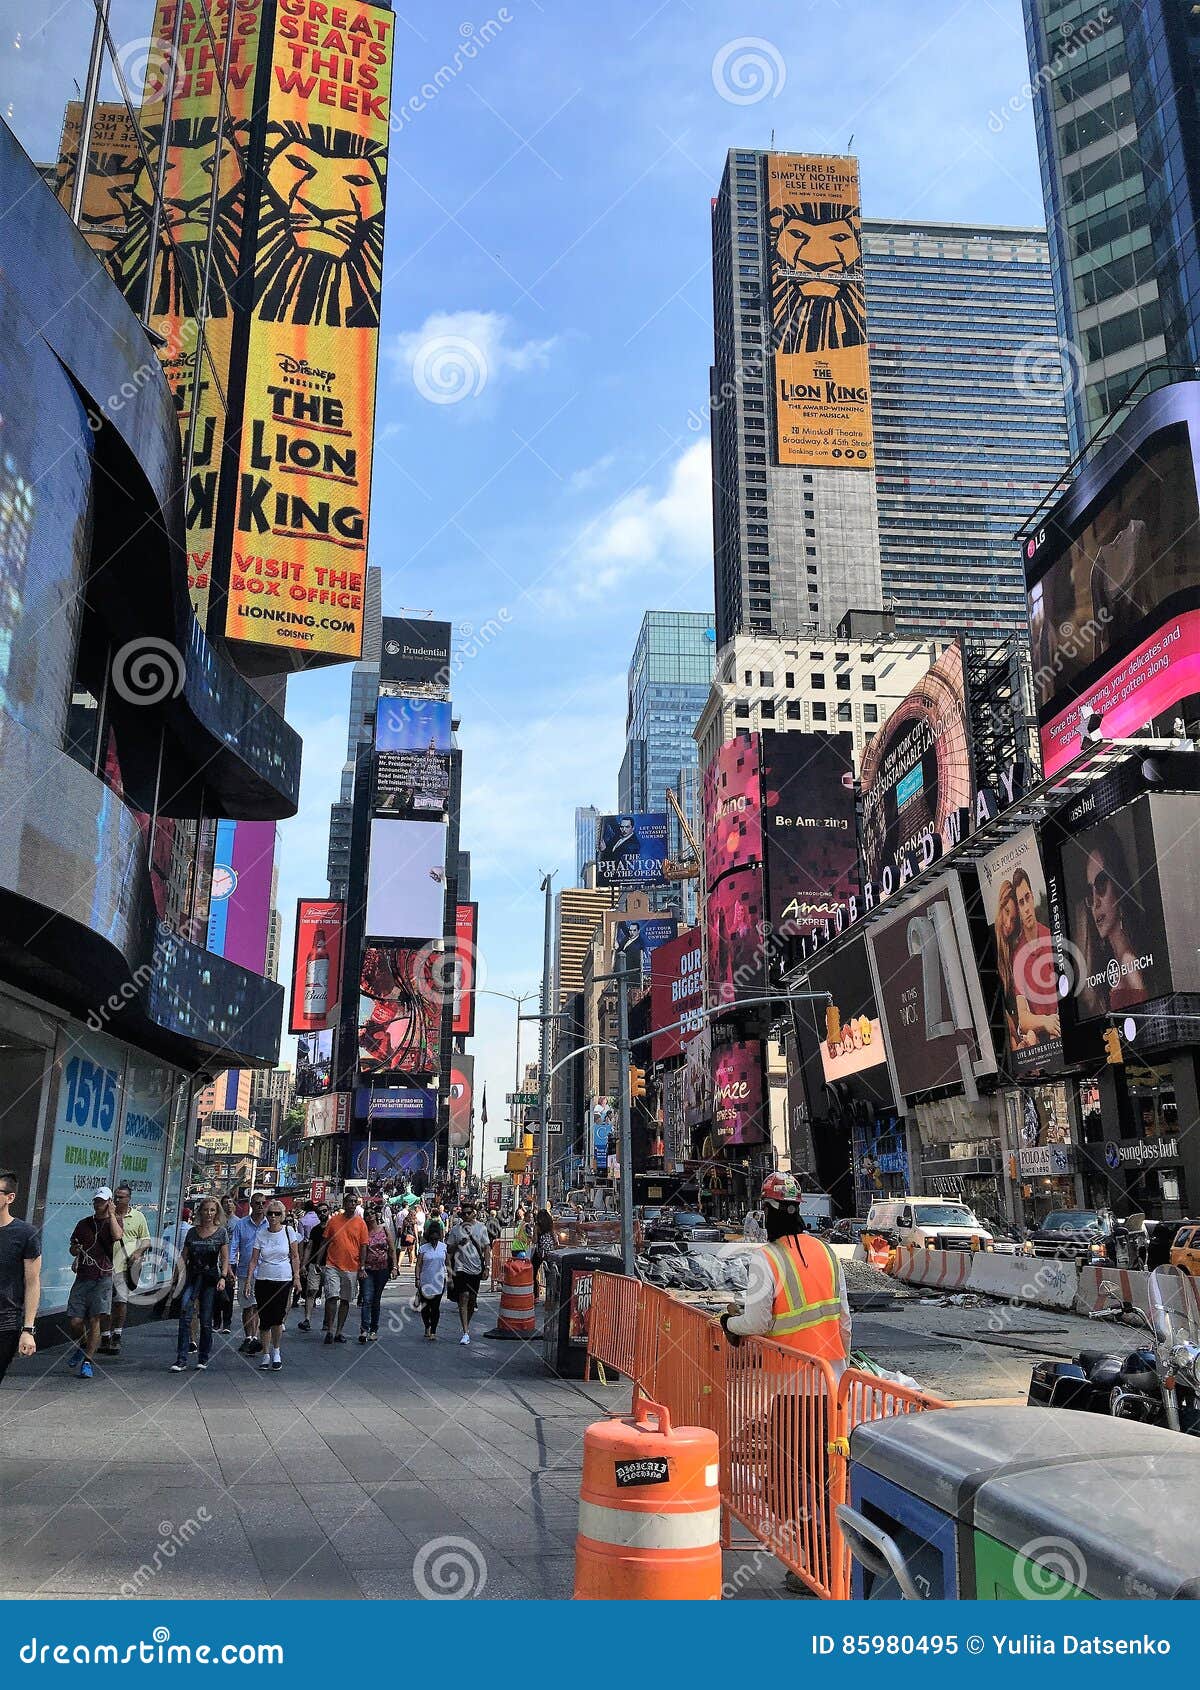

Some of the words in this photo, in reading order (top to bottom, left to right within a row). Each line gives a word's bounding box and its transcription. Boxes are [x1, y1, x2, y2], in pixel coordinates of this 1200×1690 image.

[279, 0, 391, 41] GREAT
[279, 16, 388, 65] SEATS
[288, 43, 379, 90] THIS
[274, 65, 389, 121] WEEK
[771, 171, 806, 181] SIMPLY
[809, 173, 858, 183] NOTHING
[826, 165, 836, 173] IS
[785, 180, 806, 190] ELSE
[810, 182, 830, 191] LIKE
[812, 368, 832, 378] THE
[780, 379, 821, 402] LION
[825, 381, 868, 404] KING
[267, 385, 344, 428] THE
[803, 404, 865, 413] AWARD-WINNING
[819, 412, 850, 420] MUSICAL
[782, 436, 821, 446] Broadway
[831, 438, 849, 446] 45th
[802, 427, 834, 436] Minskoff
[249, 419, 357, 478] LION
[237, 473, 365, 541] KING
[1034, 528, 1046, 550] LG
[233, 551, 305, 581] VISIT
[314, 566, 362, 592] THE
[231, 574, 281, 598] BOX
[289, 584, 361, 610] OFFICE
[237, 604, 356, 634] LIONKING.COM
[402, 645, 447, 657] Prudential
[1110, 671, 1127, 693] your
[1128, 641, 1162, 675] delicates
[1163, 625, 1181, 647] and
[1100, 695, 1120, 713] never
[1121, 674, 1145, 701] gotten
[1147, 653, 1170, 680] along.
[880, 744, 923, 791] SUSTAINABLE
[775, 815, 792, 827] Be
[597, 858, 664, 873] PHANTOM
[623, 853, 641, 861] THE
[603, 870, 615, 878] OF
[617, 870, 633, 878] THE
[634, 869, 662, 877] OPERA
[796, 918, 825, 926] EXPRE
[680, 948, 701, 976] OUR
[1086, 973, 1107, 989] TORY
[1121, 953, 1154, 976] BURCH
[65, 1056, 118, 1133] 1515
[1021, 1150, 1041, 1166] POLO
[1118, 1140, 1158, 1166] sunglass
[1158, 1137, 1179, 1158] hut
